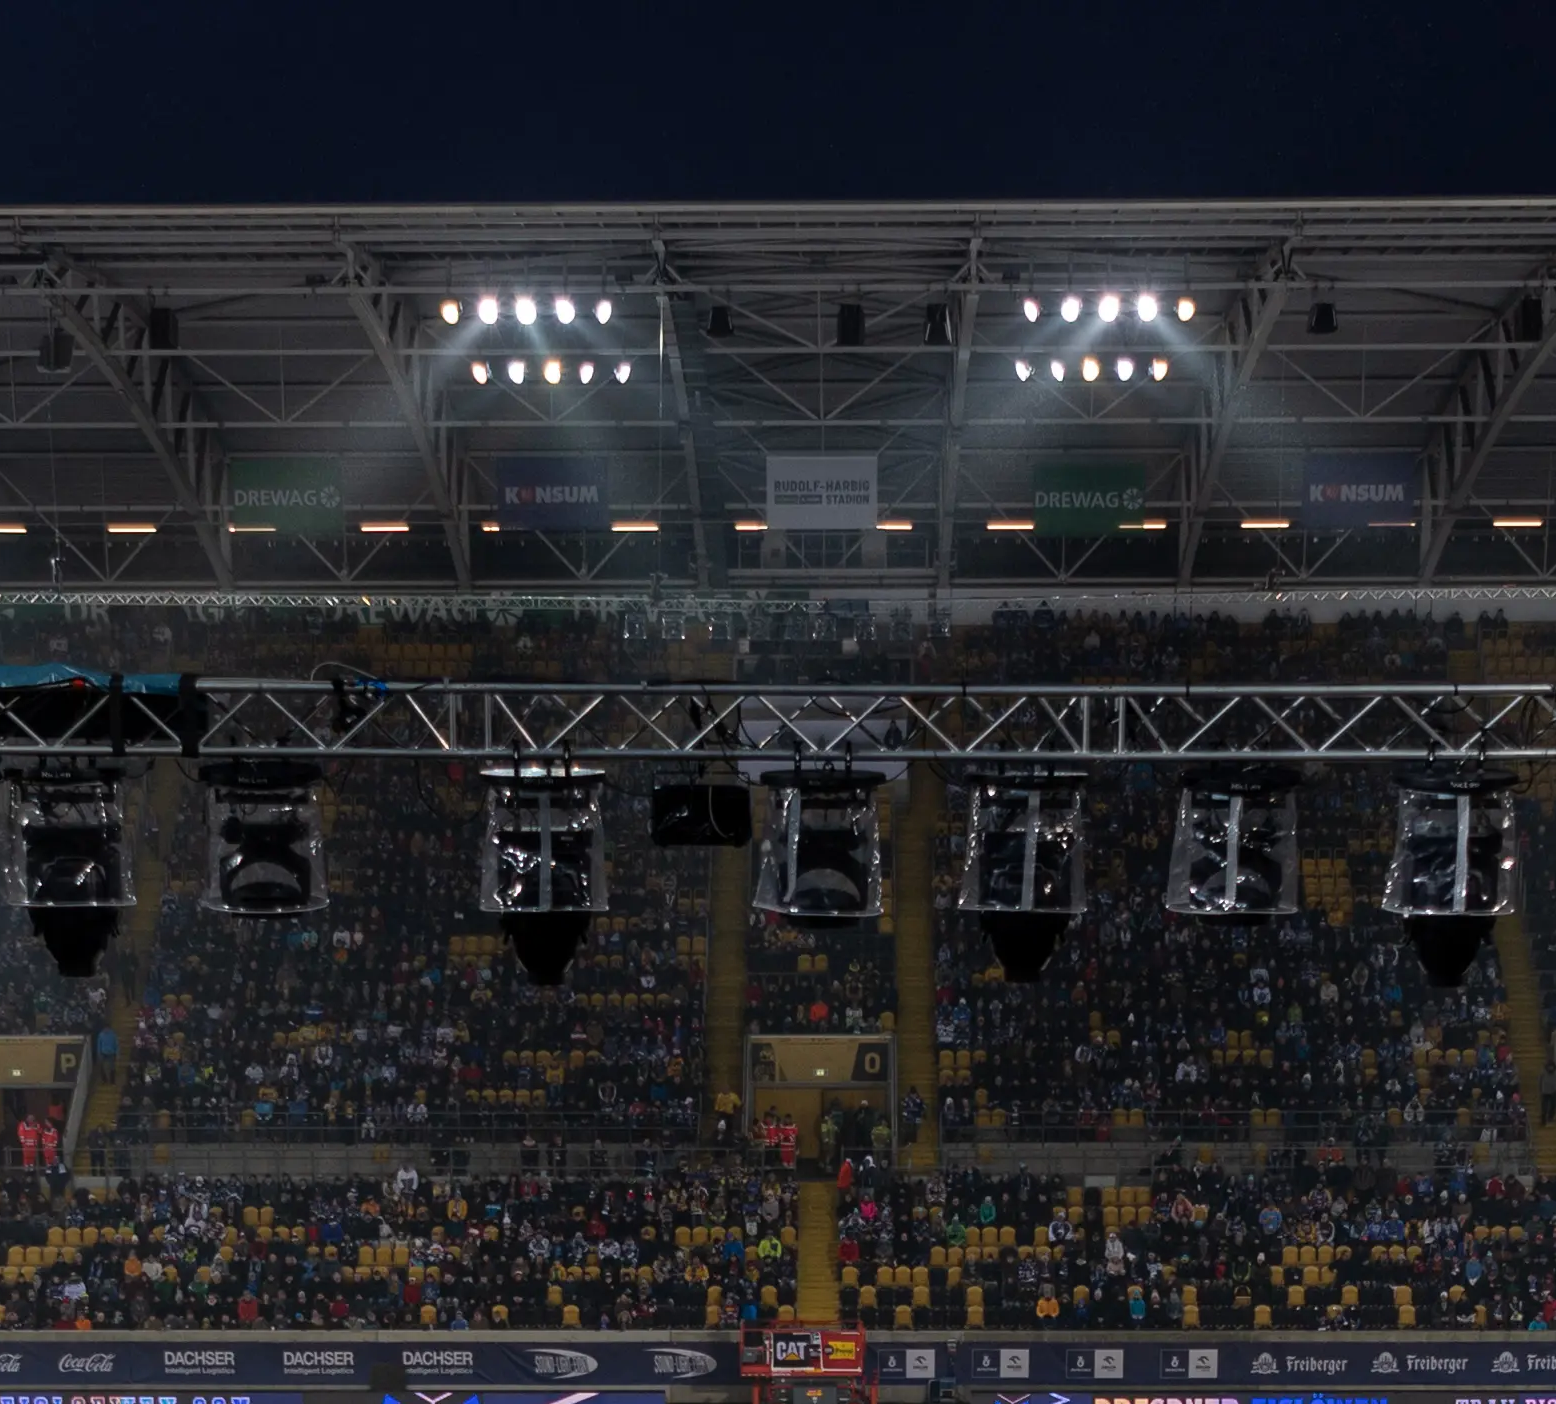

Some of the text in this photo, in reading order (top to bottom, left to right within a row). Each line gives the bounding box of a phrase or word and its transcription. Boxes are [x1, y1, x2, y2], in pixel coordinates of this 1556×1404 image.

[774, 480, 870, 492] RUDOLF-HARBIG
[235, 490, 317, 506] DREWAG
[826, 495, 870, 505] STADION
[1035, 492, 1119, 508] DREWAG
[61, 1053, 76, 1073] P
[865, 1053, 881, 1073] O
[165, 1351, 235, 1366] DACHSER
[284, 1351, 354, 1366] DACHSER
[403, 1351, 473, 1366] DACHSER
[776, 1342, 808, 1361] CAT
[1286, 1356, 1348, 1375] Freiberger
[1406, 1356, 1468, 1375] Freiberger
